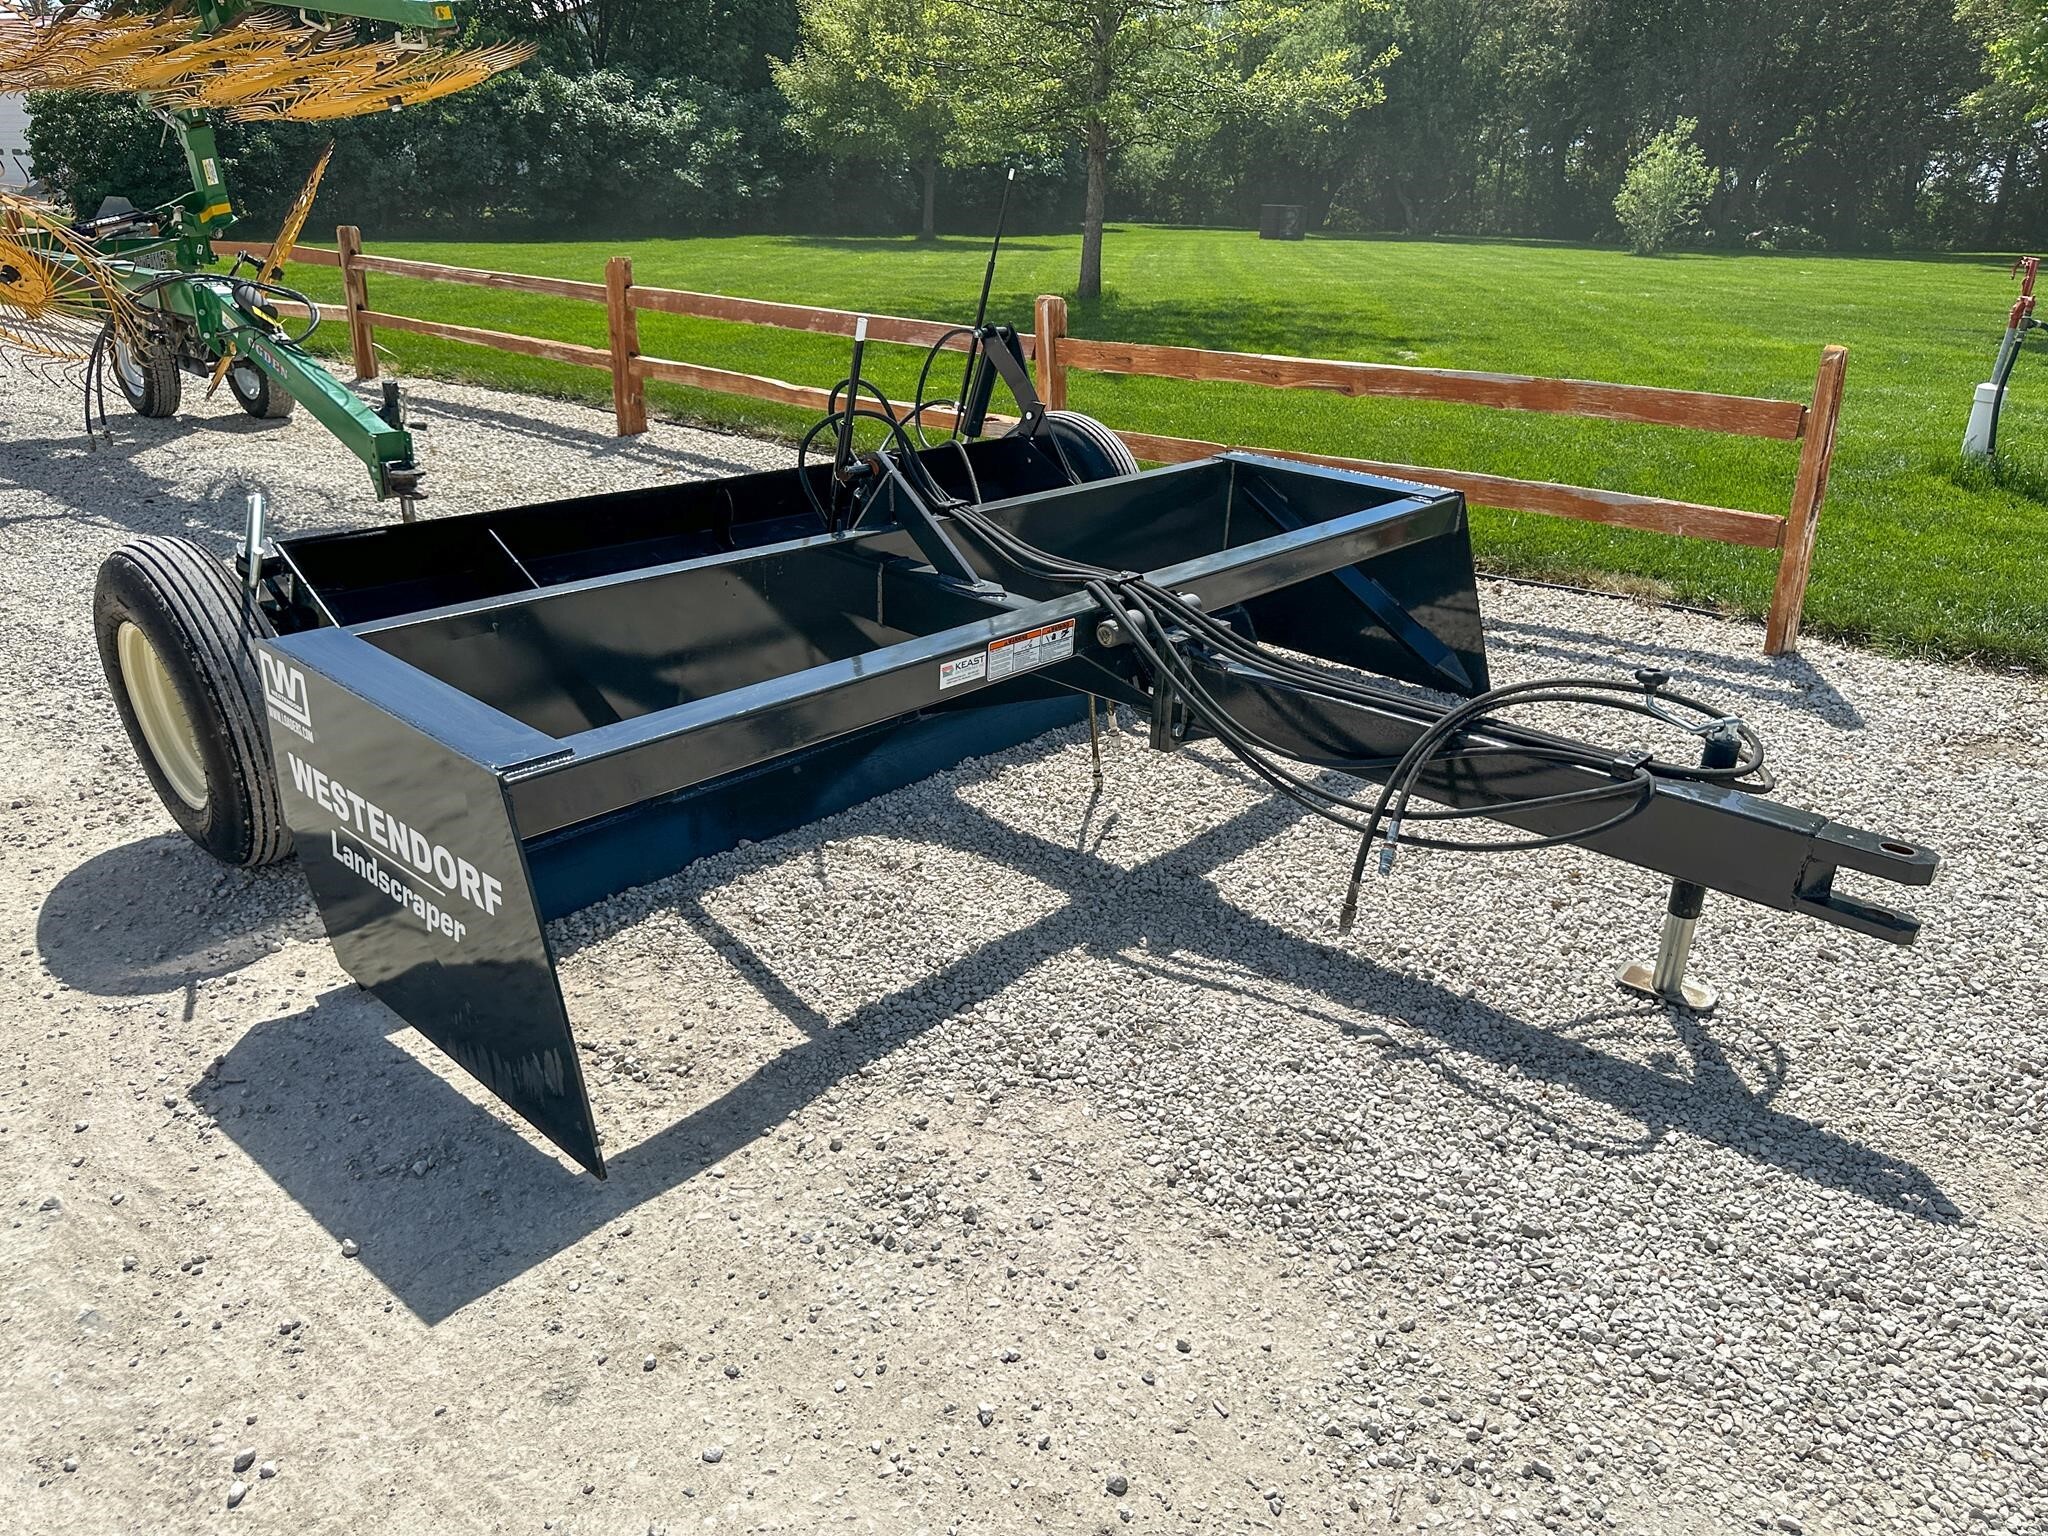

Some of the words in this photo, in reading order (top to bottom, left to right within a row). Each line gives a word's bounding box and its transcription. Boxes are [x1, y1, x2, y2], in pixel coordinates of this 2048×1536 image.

[955, 655, 984, 671] KEAST
[288, 752, 502, 916] WESTENDORF
[331, 829, 466, 943] Landscraper
